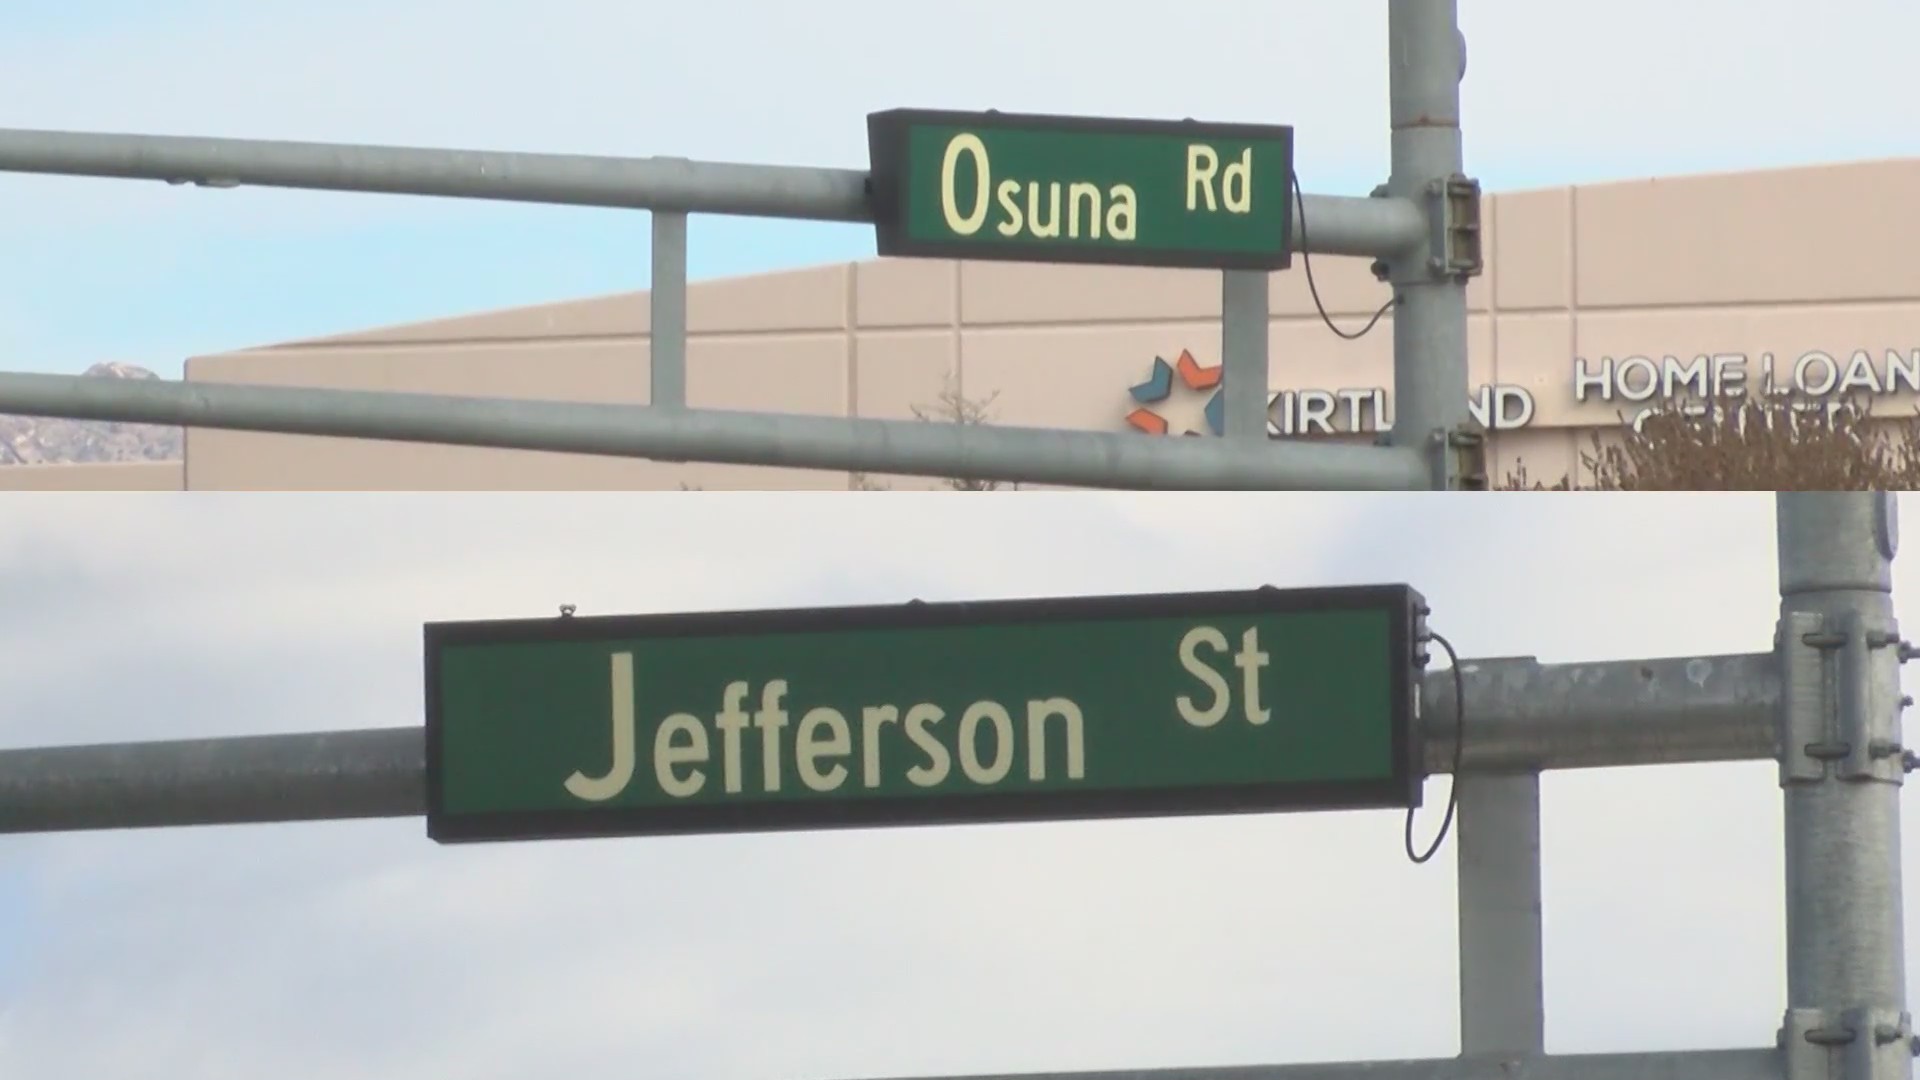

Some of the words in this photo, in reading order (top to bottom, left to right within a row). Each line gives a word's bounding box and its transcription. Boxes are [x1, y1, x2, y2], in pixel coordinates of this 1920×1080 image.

[941, 132, 1137, 241] Osuna
[1186, 144, 1252, 214] Rd
[1268, 384, 1533, 435] IRTLND
[1574, 353, 1748, 401] HOME
[1762, 349, 1920, 396] LOAN
[564, 652, 1086, 801] Jefferson
[1176, 626, 1271, 727] St
